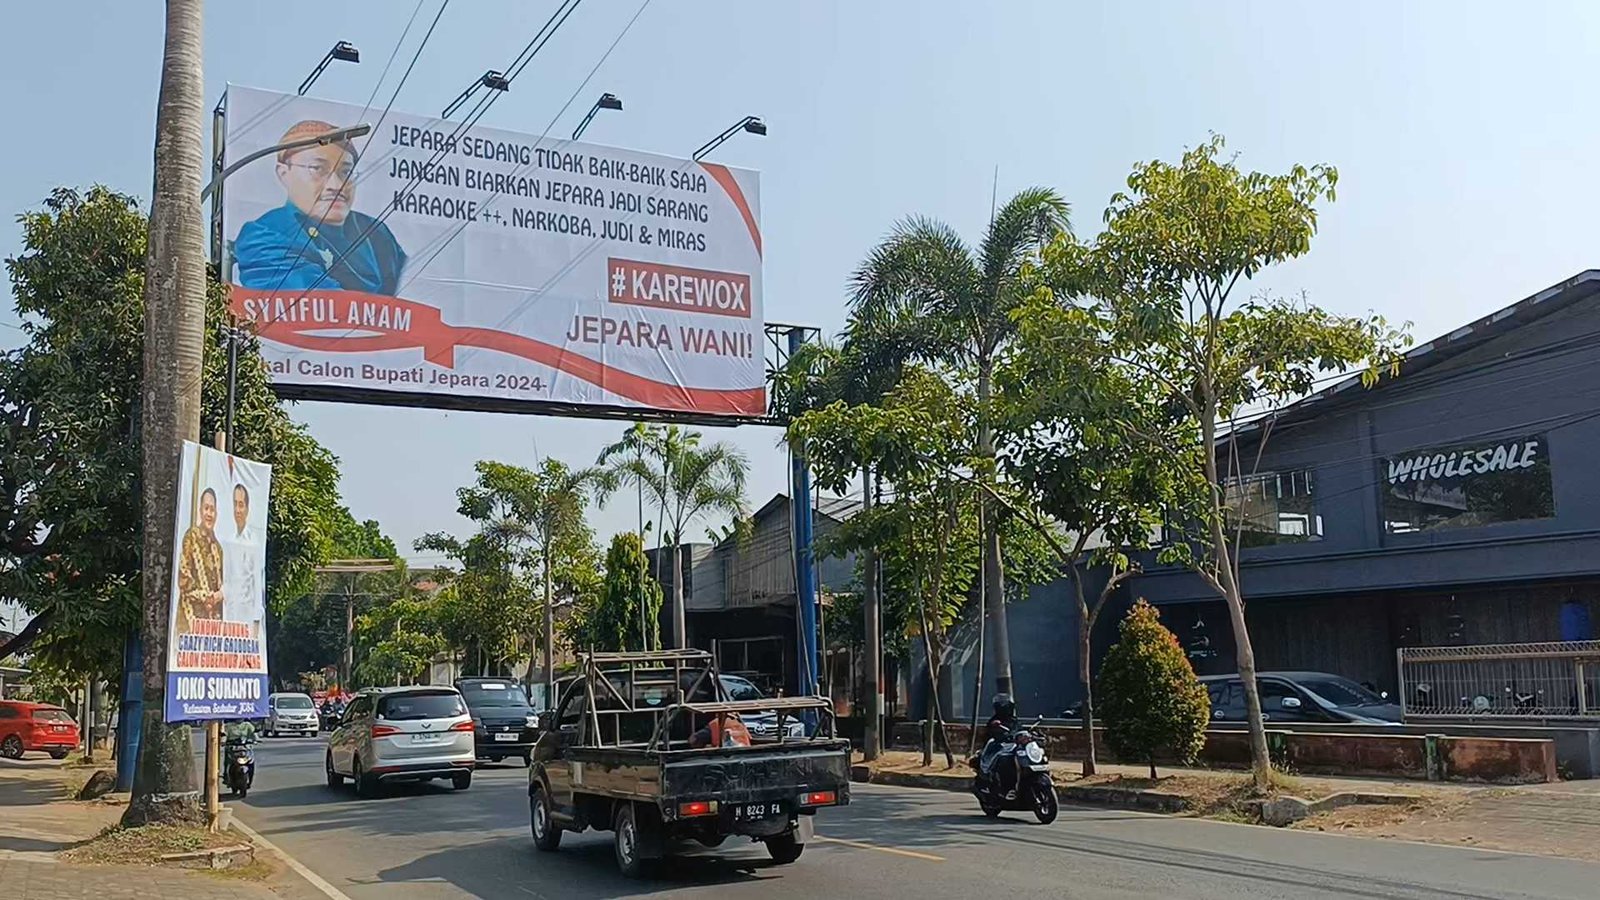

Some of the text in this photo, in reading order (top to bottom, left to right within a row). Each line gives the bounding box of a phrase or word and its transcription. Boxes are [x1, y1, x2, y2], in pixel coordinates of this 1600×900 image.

[392, 124, 707, 193] JEPARA SEDANG TIDAK BAIK-BAIK SAJA
[390, 157, 709, 223] JANGAN BIARKAN JEPARA JADI SARANG
[392, 190, 478, 222] KARAOKE
[512, 207, 597, 239] NARKOBA,
[600, 220, 633, 242] JUDI
[638, 226, 652, 245] &
[658, 228, 706, 252] MIRAS
[612, 267, 746, 311] # KAREWOX
[243, 296, 412, 332] SYAIFUL ANAM
[566, 315, 753, 359] JEPARA WANI!
[297, 359, 354, 378] Calon
[362, 364, 424, 384] Bupati
[429, 369, 489, 388] Jepara
[1388, 441, 1539, 485] WHOLESALE
[176, 651, 199, 668] CALON
[200, 652, 239, 669] GUBERNUR
[178, 635, 202, 651] CRAZY
[204, 636, 223, 652] RICH
[176, 676, 261, 700] JOKO SURANTO
[735, 803, 781, 817] H 8243 FA
